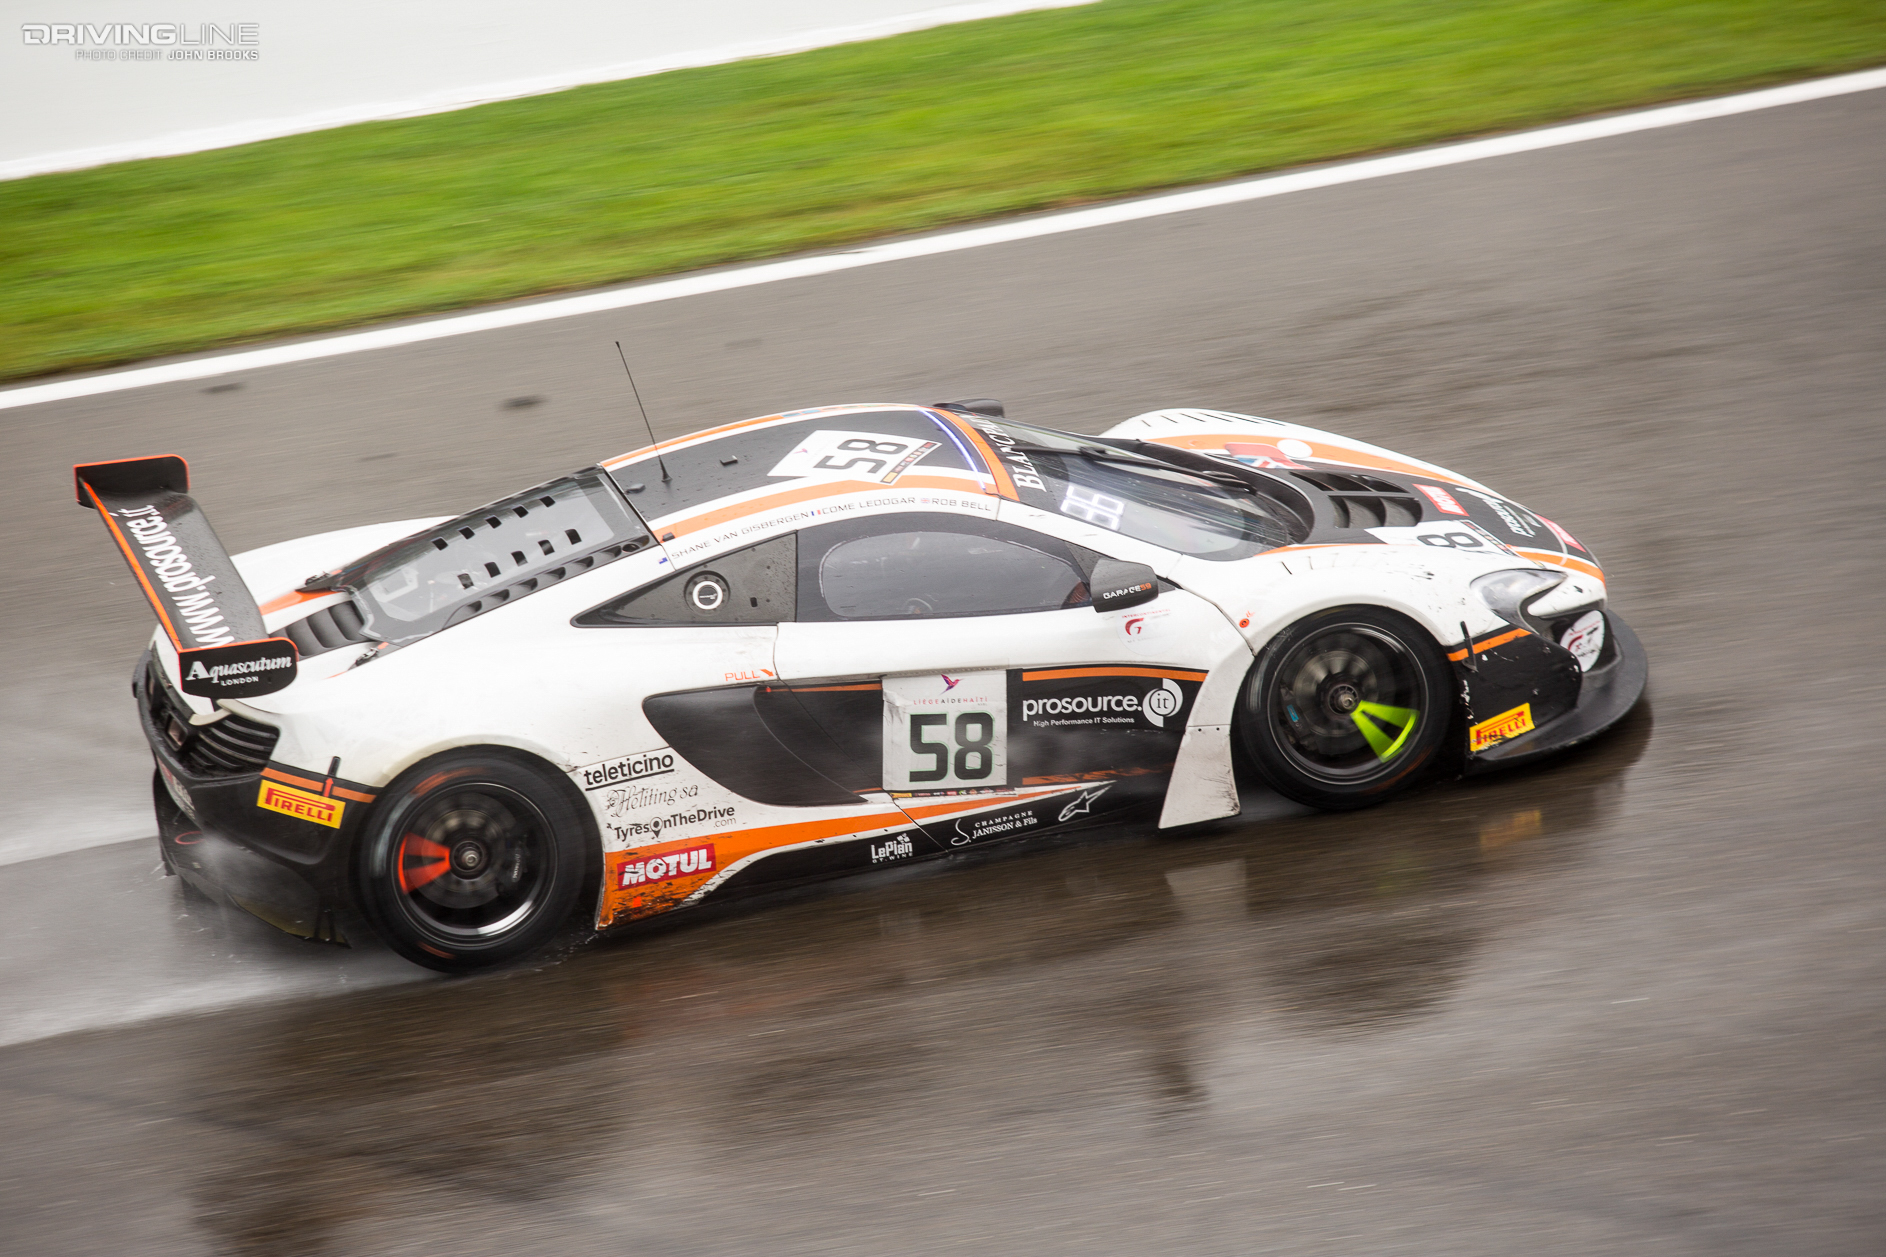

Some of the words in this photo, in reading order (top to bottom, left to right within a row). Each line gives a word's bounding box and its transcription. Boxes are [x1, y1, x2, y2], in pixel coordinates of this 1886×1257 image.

[813, 438, 909, 475] 58
[859, 497, 916, 508] LEDOGAR
[932, 498, 957, 507] ROB
[961, 500, 992, 512] BELL
[671, 541, 711, 559] SHANE
[714, 532, 738, 543] VAN
[741, 511, 809, 535] GISBERGEN
[185, 656, 292, 683] Aquascutum
[221, 676, 259, 686] LONDON
[725, 670, 760, 682] PULL
[1034, 719, 1049, 728] High
[1051, 718, 1093, 727] Performance
[1103, 717, 1135, 725] Solutions
[1475, 710, 1527, 746] PIRELLI
[909, 711, 996, 782] 58
[583, 754, 674, 786] teleticino
[680, 784, 699, 799] sa
[265, 787, 336, 823] PIRELLI
[971, 822, 1014, 839] JANISSON
[1014, 820, 1023, 829] &
[974, 810, 1034, 829] CHAMPAGNE
[621, 848, 713, 887] MOTUL
